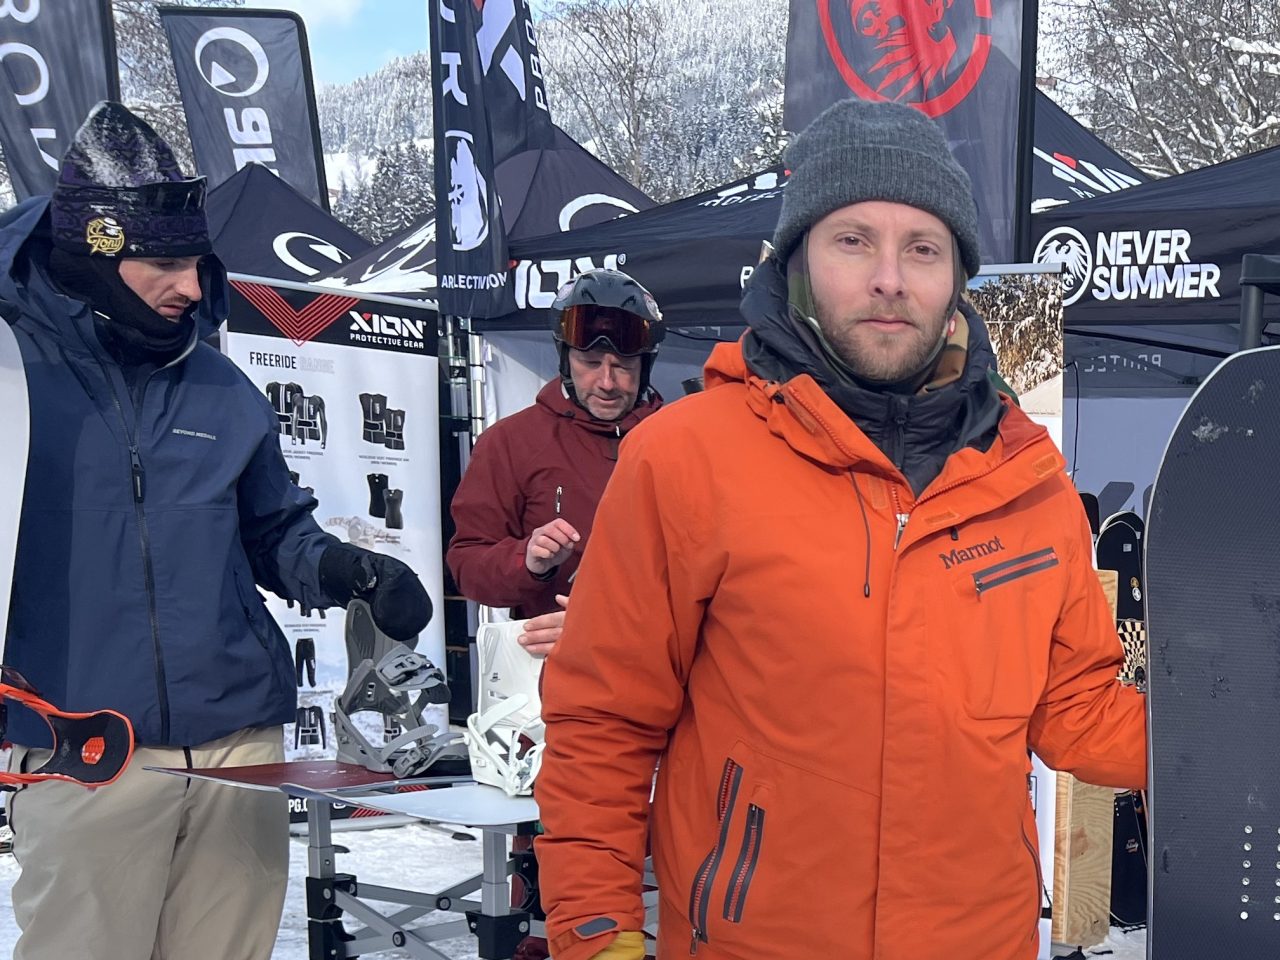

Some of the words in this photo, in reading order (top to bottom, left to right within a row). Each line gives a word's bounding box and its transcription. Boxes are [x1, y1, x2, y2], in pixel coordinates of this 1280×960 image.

[1096, 229, 1191, 265] NEVER
[1091, 263, 1221, 300] SUMMER
[349, 311, 424, 339] XION
[350, 333, 402, 347] PROTECTIVE
[404, 340, 424, 349] GEAR
[250, 351, 297, 370] FREERIDE
[939, 535, 1006, 570] Marmot
